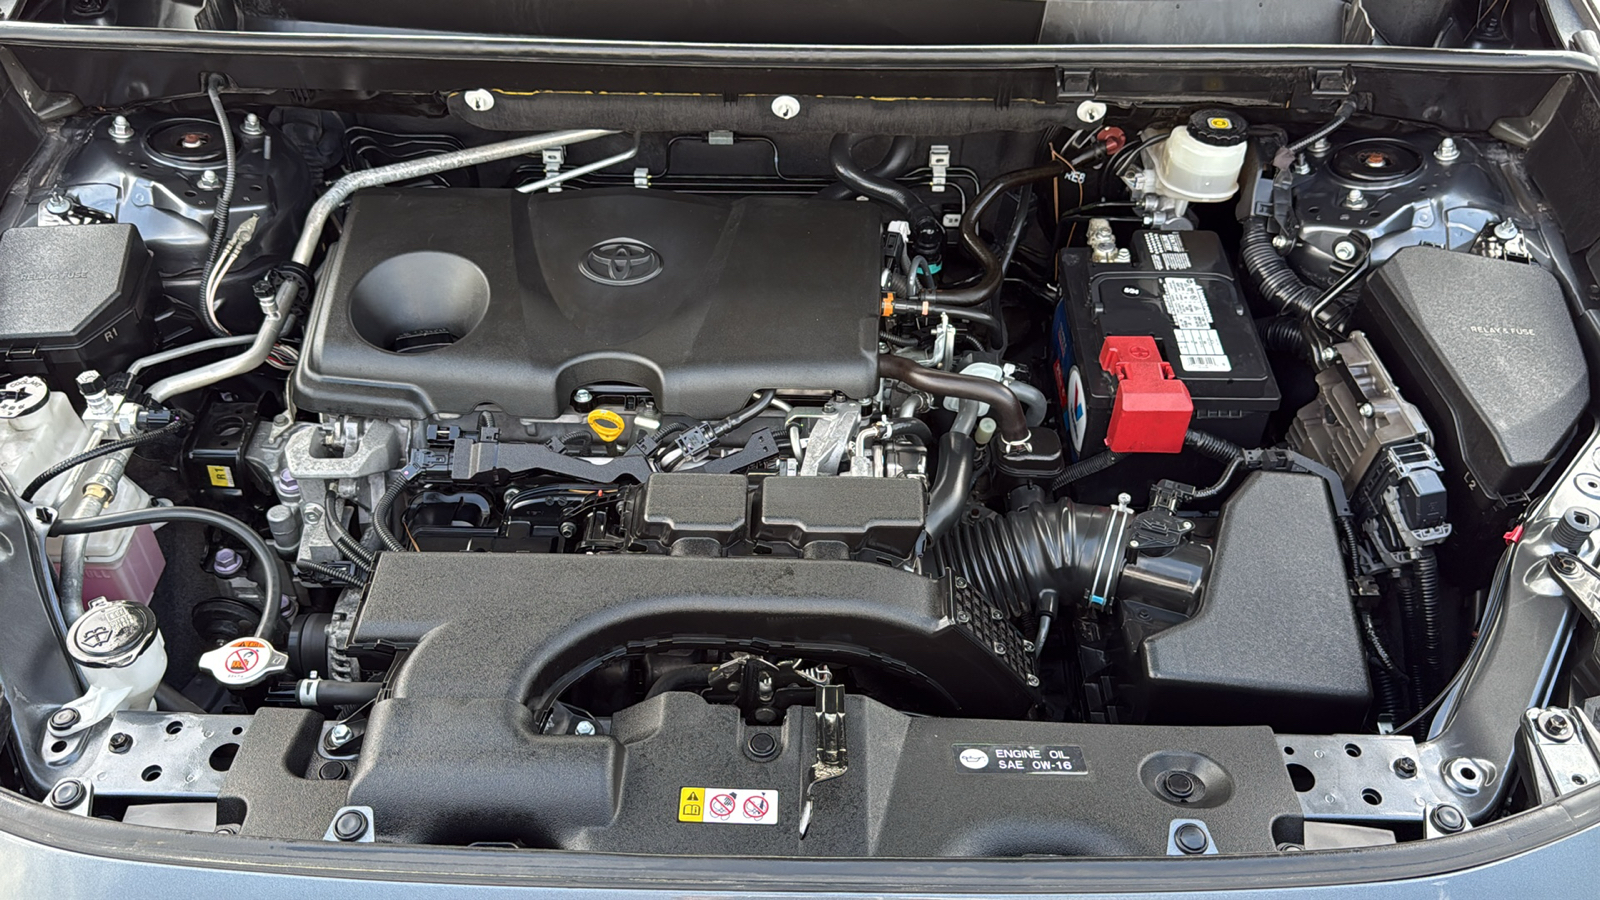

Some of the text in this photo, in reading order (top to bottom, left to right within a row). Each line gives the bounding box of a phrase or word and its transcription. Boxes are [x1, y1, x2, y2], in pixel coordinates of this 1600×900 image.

[61, 270, 88, 279] FUSE
[104, 327, 118, 342] R1
[214, 468, 226, 480] R1
[995, 749, 1070, 759] ENGINE OIL
[998, 760, 1024, 769] SAE
